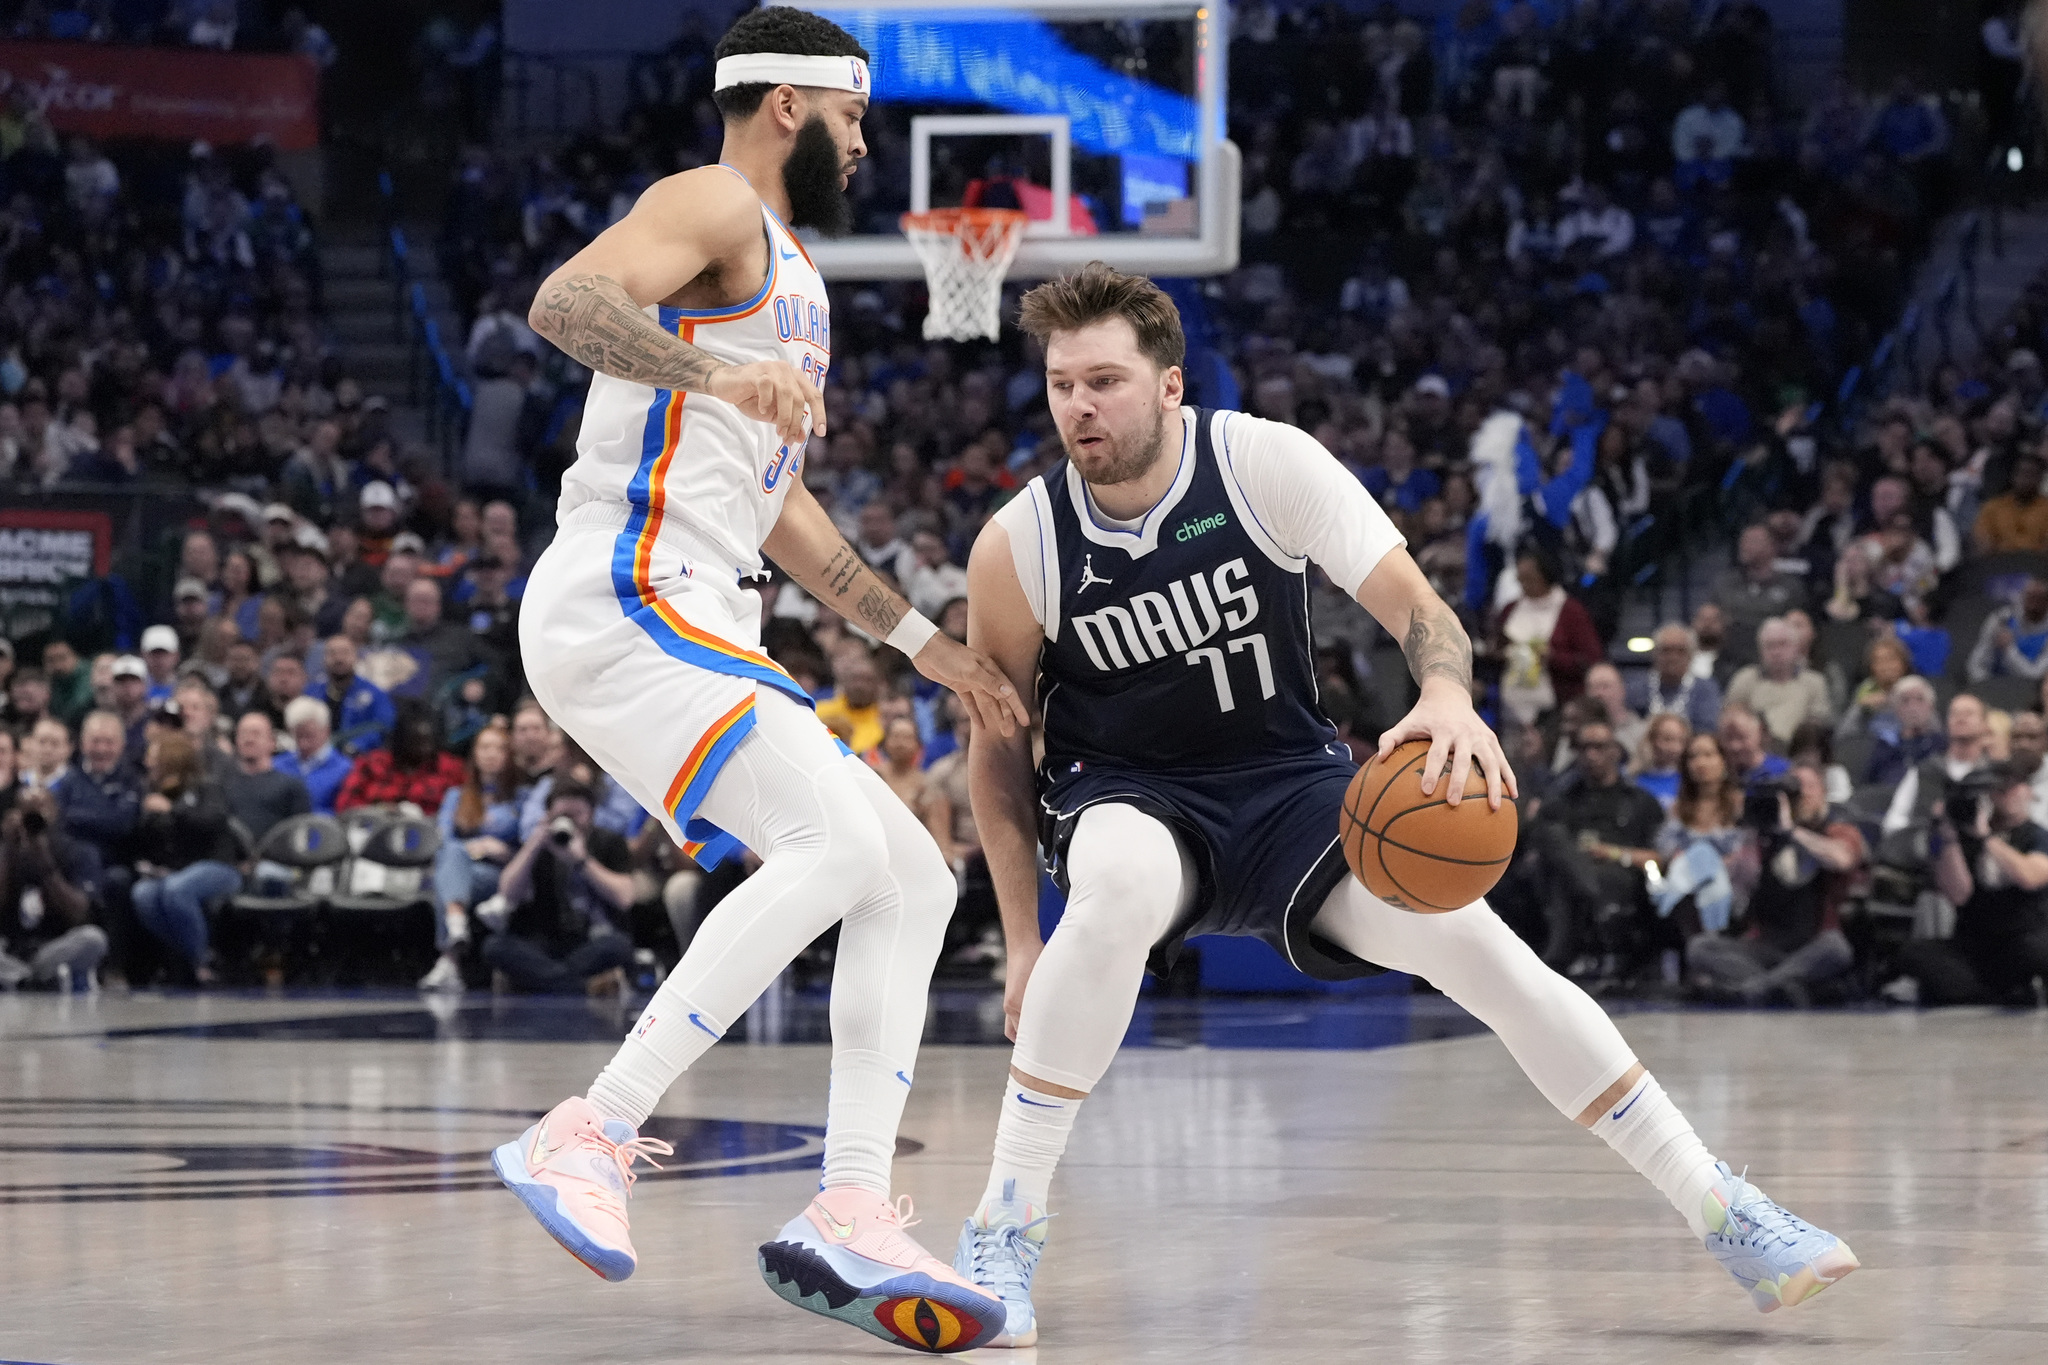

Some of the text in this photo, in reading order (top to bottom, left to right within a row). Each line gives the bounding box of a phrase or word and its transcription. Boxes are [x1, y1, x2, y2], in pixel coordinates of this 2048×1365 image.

[607, 310, 650, 340] Kendrick
[773, 293, 831, 356] OKAH
[801, 352, 828, 389] CT
[1175, 512, 1227, 542] chime
[857, 584, 884, 621] GOD
[872, 595, 898, 635] GOT
[1071, 557, 1260, 671] MAVS
[1185, 633, 1276, 713] 77
